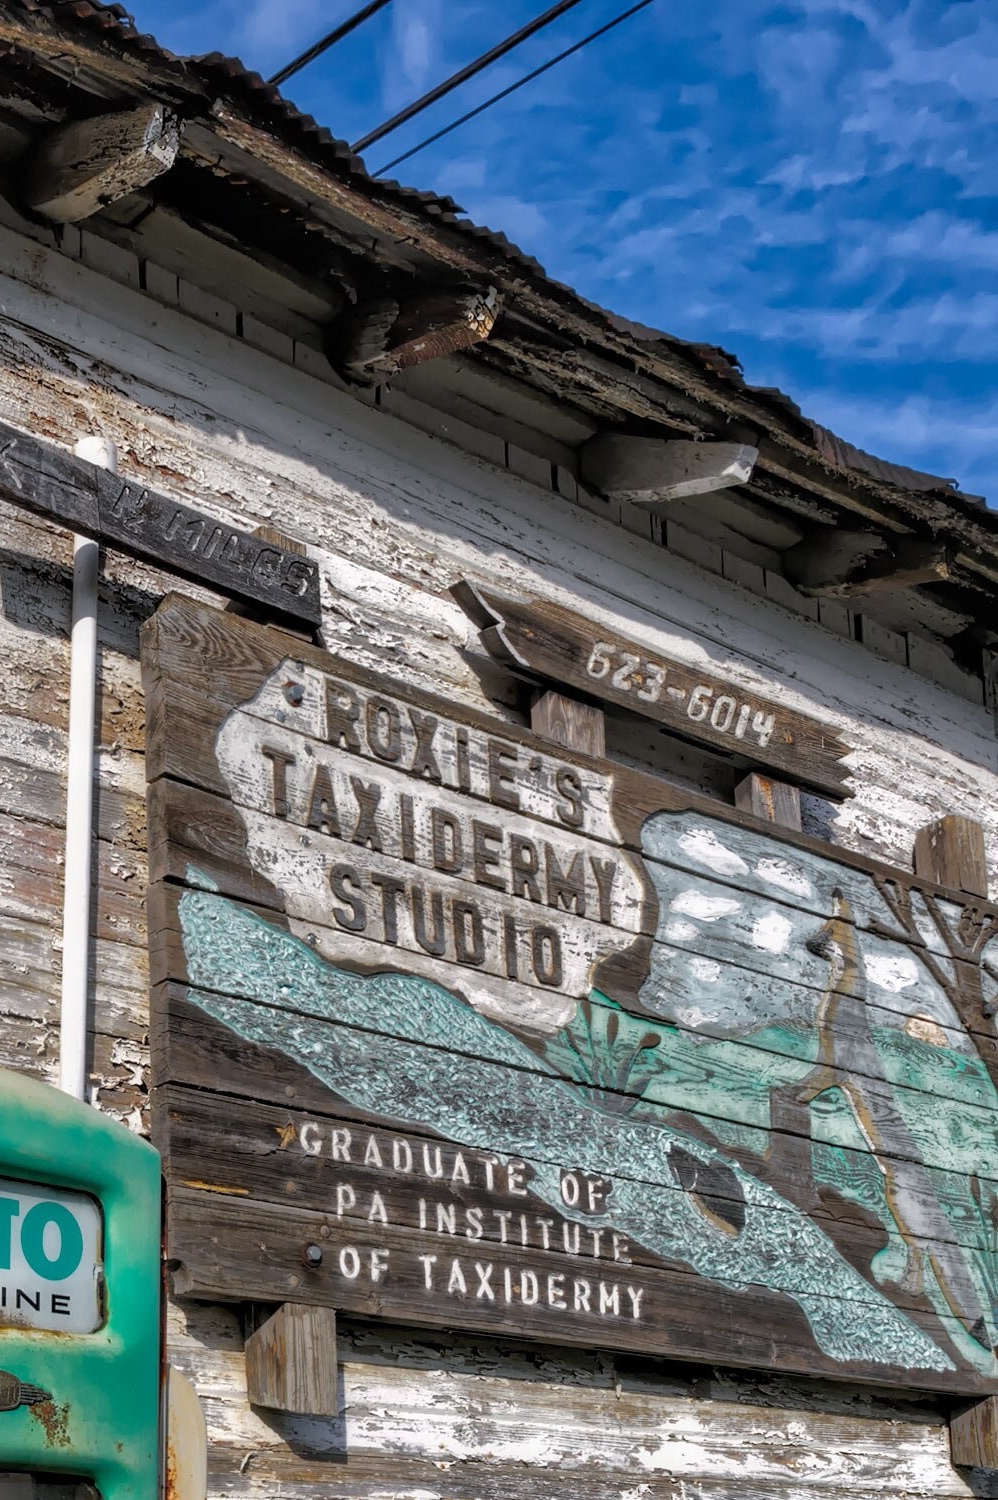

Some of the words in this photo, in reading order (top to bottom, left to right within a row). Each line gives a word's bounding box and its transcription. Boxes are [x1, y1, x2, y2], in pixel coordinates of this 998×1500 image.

[585, 640, 777, 748] 623-6014
[324, 676, 584, 828] ROXIE'S
[261, 744, 617, 925] TAXIDERMY
[328, 862, 563, 988] STUDIO
[299, 1120, 529, 1197] GRADUATE
[560, 1172, 606, 1212] OF
[335, 1181, 389, 1227] PA
[417, 1197, 634, 1267] INSTITUTE
[338, 1244, 391, 1283] OF
[418, 1253, 645, 1320] TAXIDERMY
